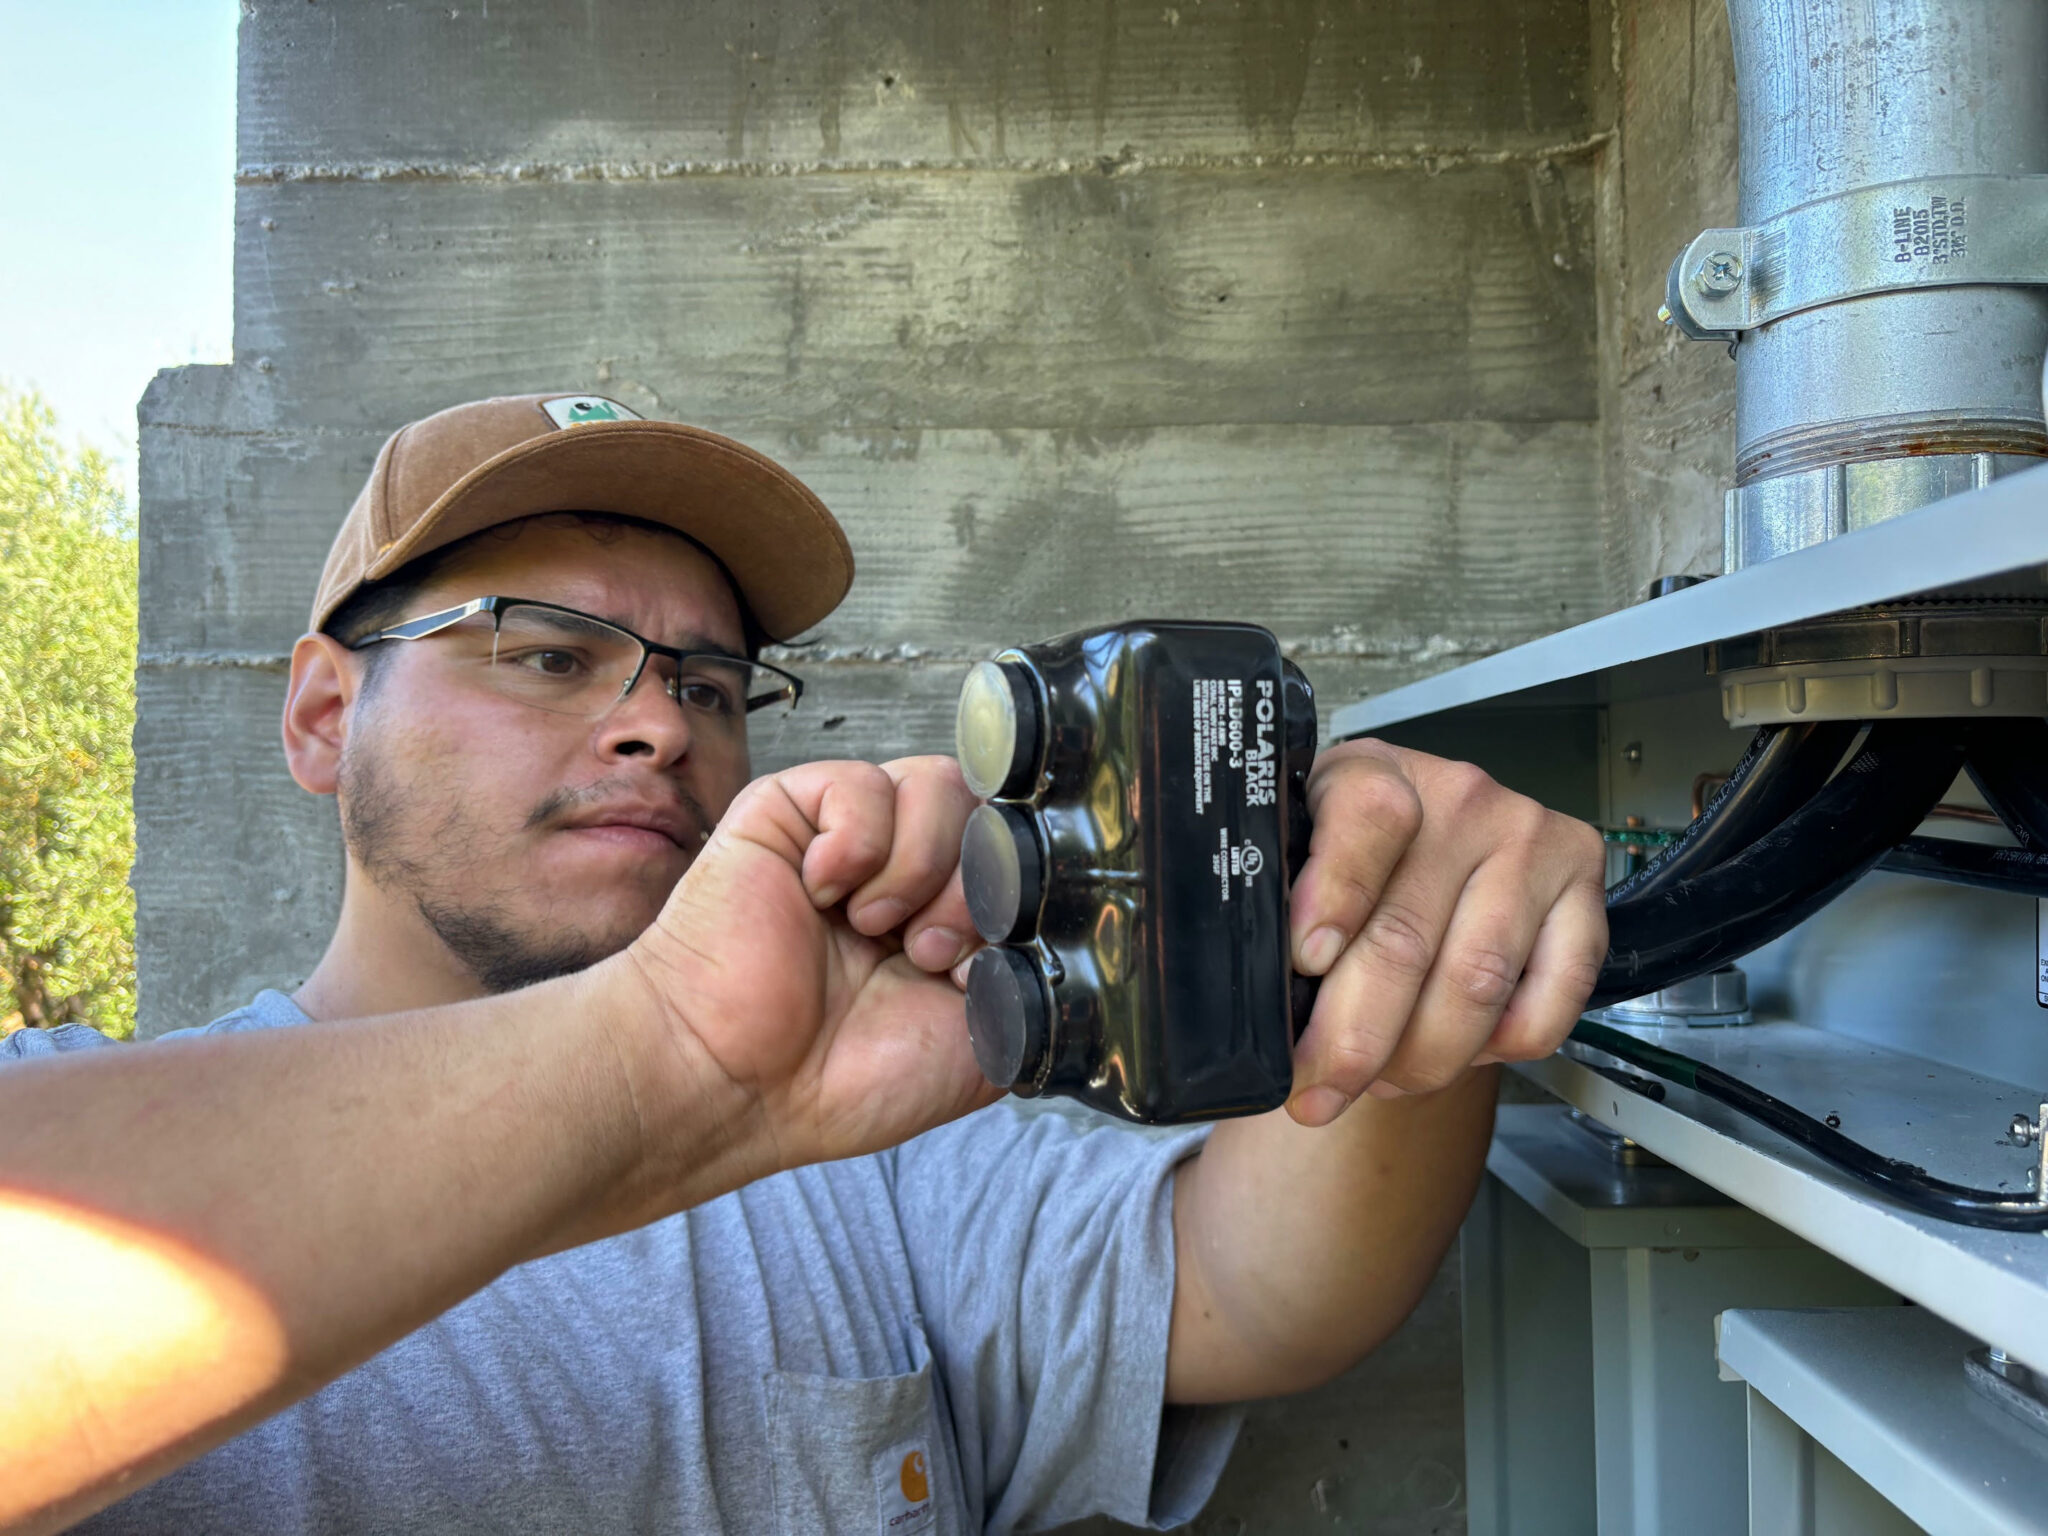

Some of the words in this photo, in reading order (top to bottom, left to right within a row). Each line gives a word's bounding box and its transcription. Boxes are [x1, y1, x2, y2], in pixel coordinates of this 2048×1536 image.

[1894, 207, 1912, 263] B-LINE
[1913, 209, 1930, 256] B2015
[1193, 680, 1201, 698] LINE
[1202, 680, 1210, 719] SUITABLE
[1193, 700, 1201, 718] SIDE
[1194, 719, 1202, 731] OF
[1202, 720, 1210, 736] FOR
[1210, 727, 1218, 745] MAX
[1218, 727, 1227, 746] AWG
[1227, 680, 1243, 768] IPLD600-3
[1194, 732, 1203, 766] SERVICE
[1255, 680, 1276, 805] POLARIS
[1203, 755, 1211, 771] USE
[1203, 772, 1212, 785] ON
[1245, 749, 1259, 807] BLACK
[1194, 767, 1204, 815] EQUIPMENT
[1203, 786, 1212, 803] THE
[1220, 827, 1229, 849] WIRE
[1231, 846, 1240, 875] LISTED
[1221, 850, 1230, 902] CONNECTOR
